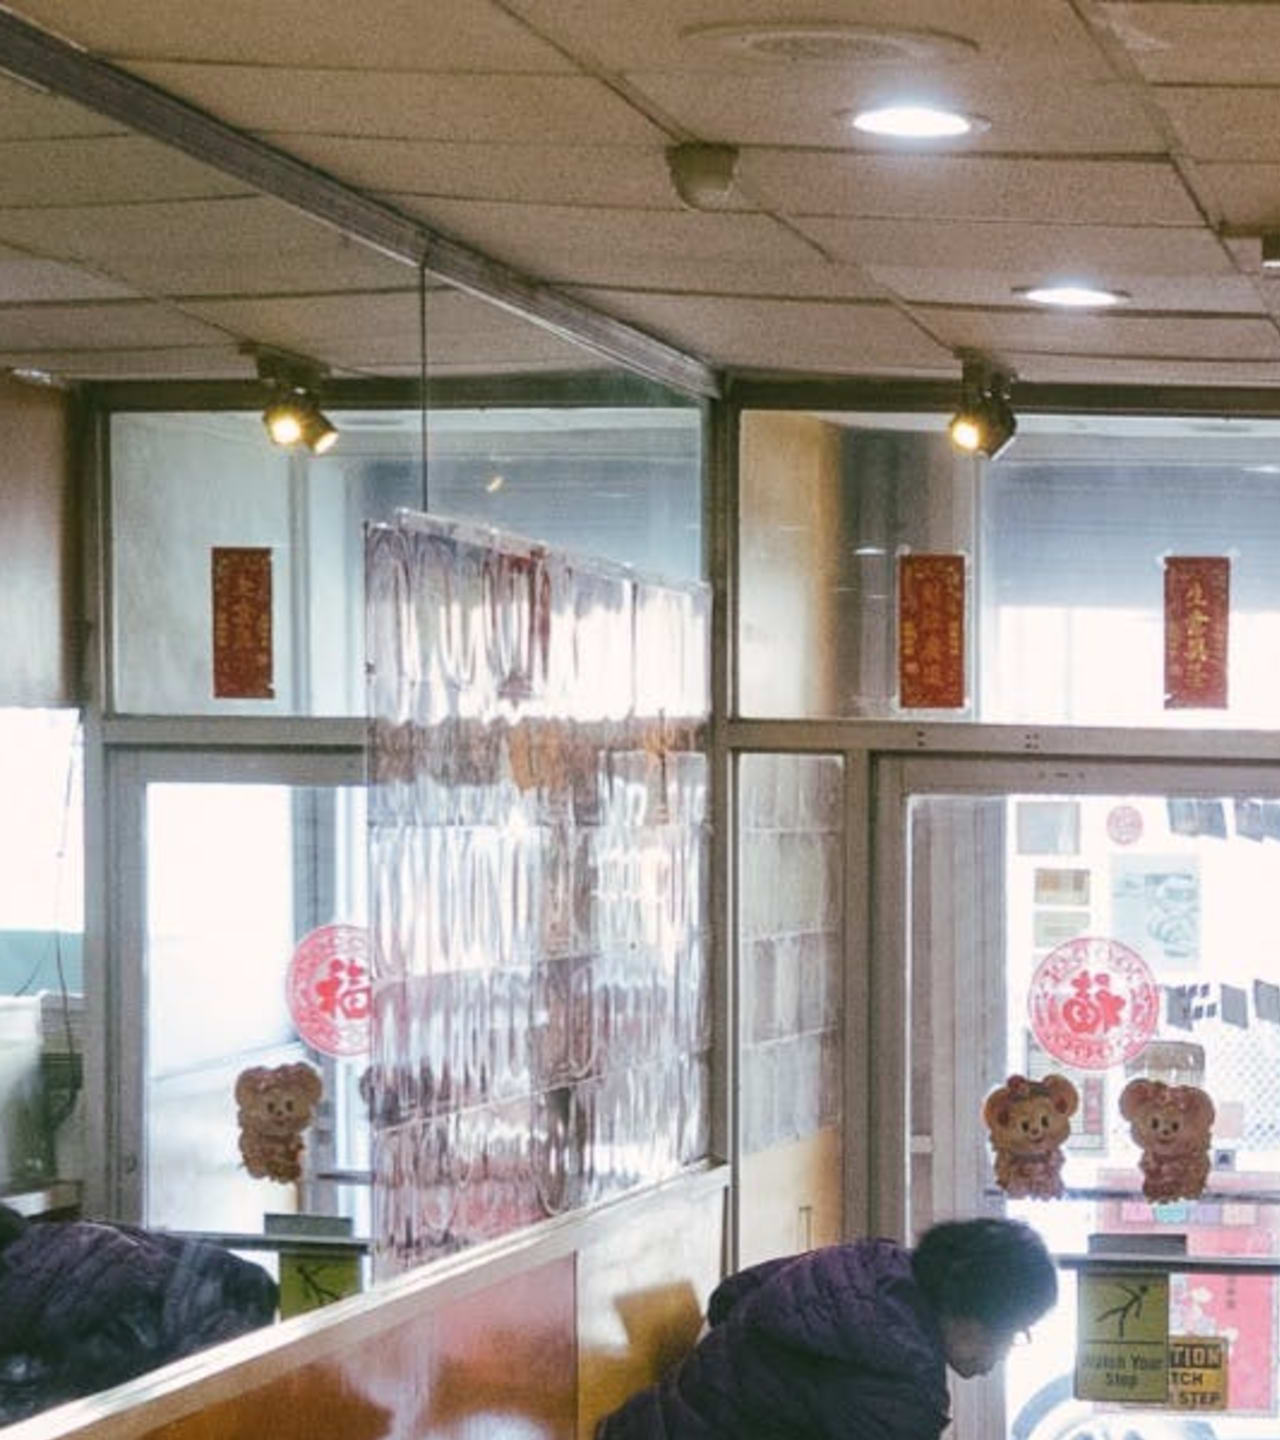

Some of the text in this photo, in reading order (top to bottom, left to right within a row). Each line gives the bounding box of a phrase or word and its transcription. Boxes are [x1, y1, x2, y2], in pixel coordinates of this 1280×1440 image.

[1082, 1352, 1163, 1370] Watch Your
[1170, 1344, 1221, 1368] TION
[1105, 1372, 1138, 1391] Step
[1170, 1373, 1204, 1385] TCH
